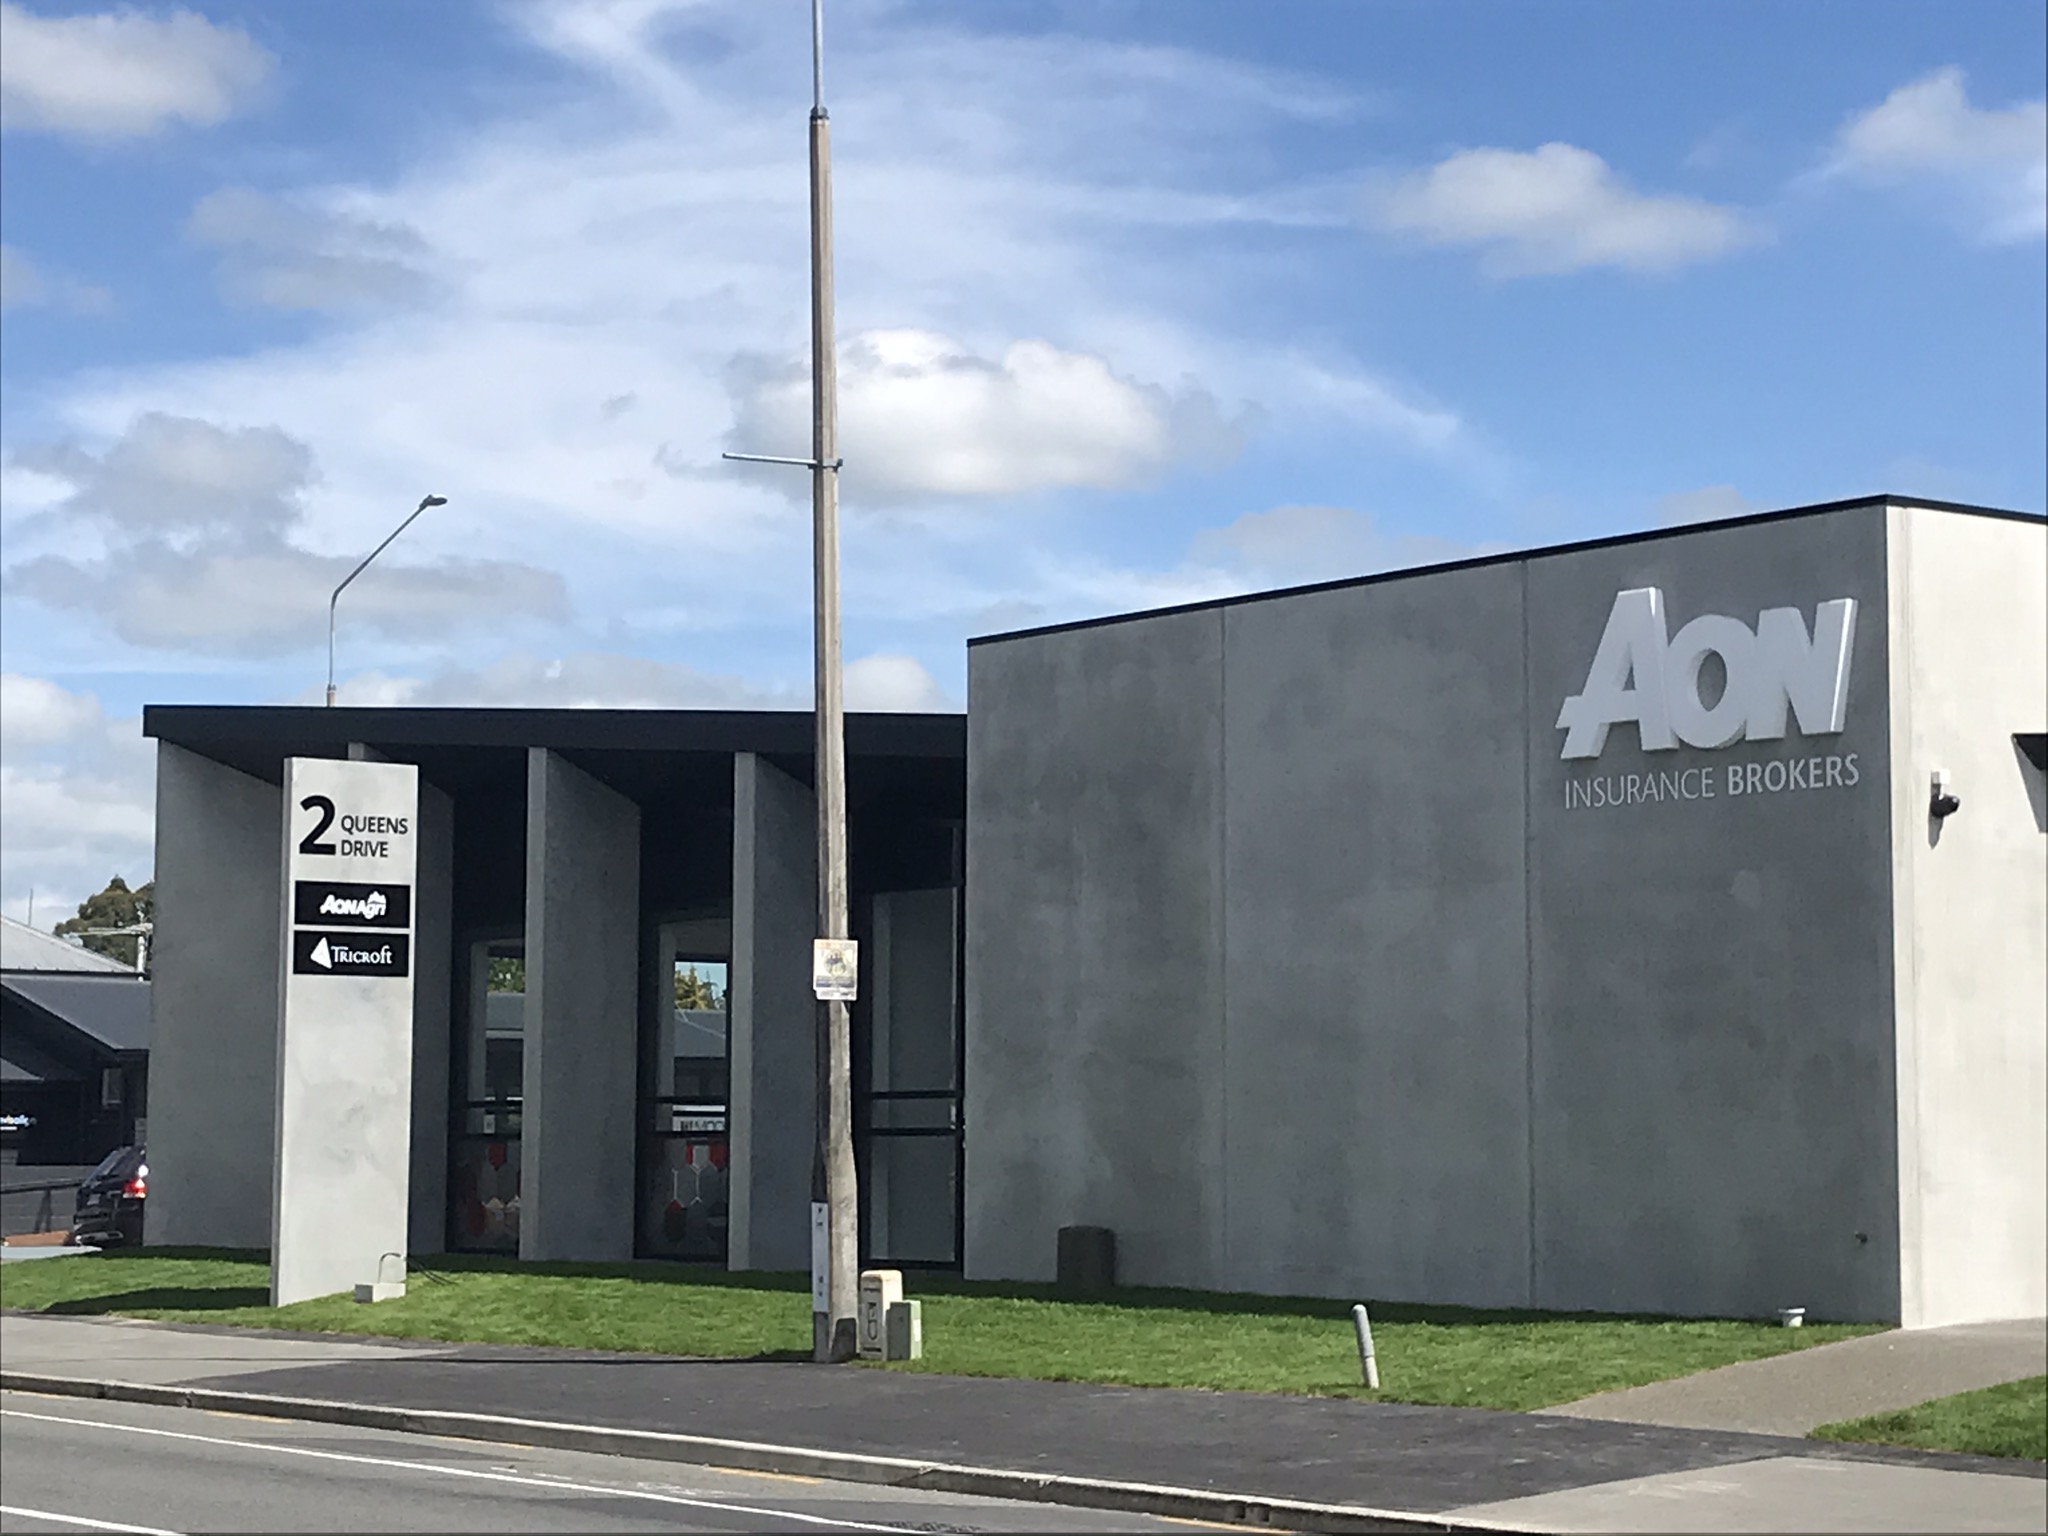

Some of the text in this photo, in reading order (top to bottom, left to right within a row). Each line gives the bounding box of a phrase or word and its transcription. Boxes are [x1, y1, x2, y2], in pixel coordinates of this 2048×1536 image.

[1555, 586, 1858, 760] AON
[1565, 753, 1859, 809] INSURANCE BROKERS
[299, 795, 408, 855] 2 QUEENS
[341, 840, 389, 857] DRIVE
